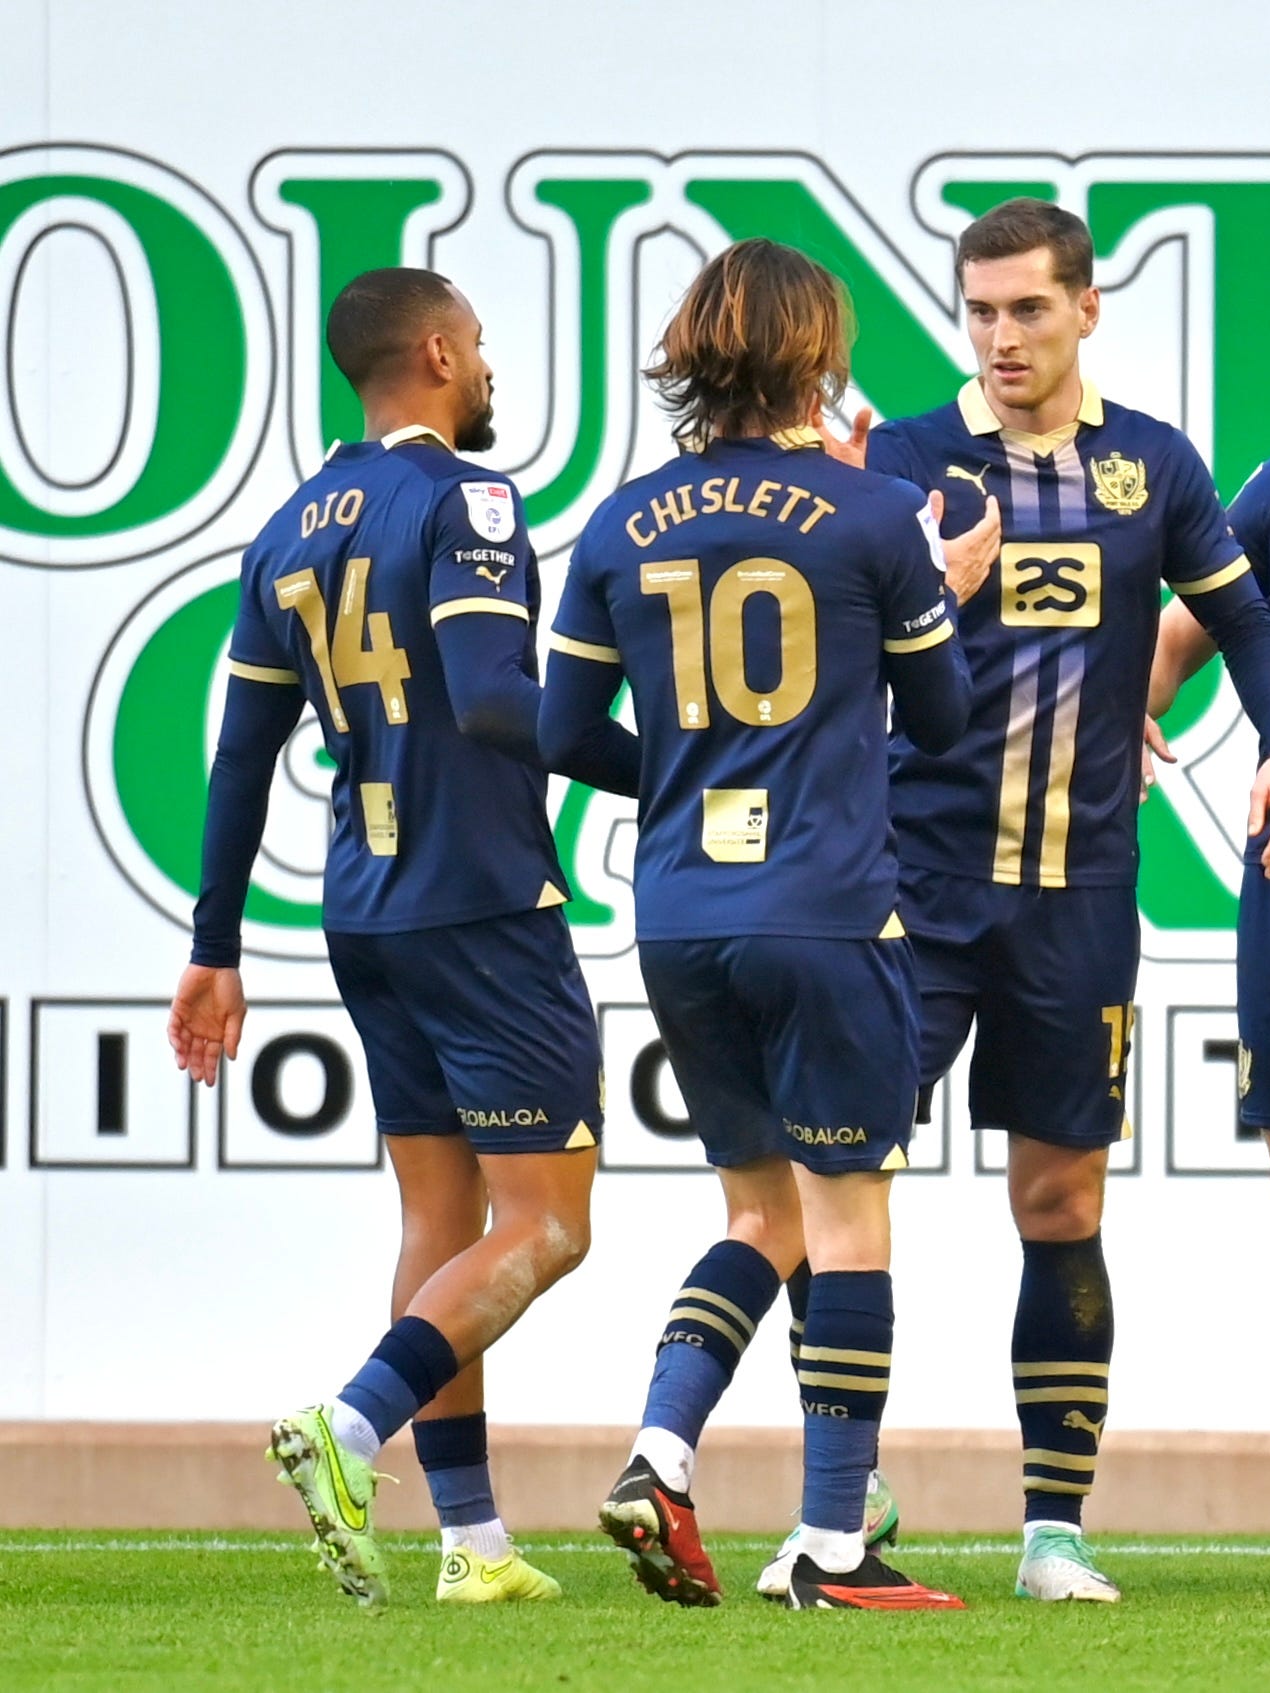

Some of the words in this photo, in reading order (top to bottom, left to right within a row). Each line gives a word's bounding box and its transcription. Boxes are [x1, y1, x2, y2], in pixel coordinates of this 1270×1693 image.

[301, 488, 364, 539] OJO
[625, 477, 836, 548] CHISLETT
[455, 548, 515, 567] TOGETHER
[274, 557, 411, 733] 14
[640, 557, 816, 729] 10
[782, 1117, 867, 1145] OBAL-QA
